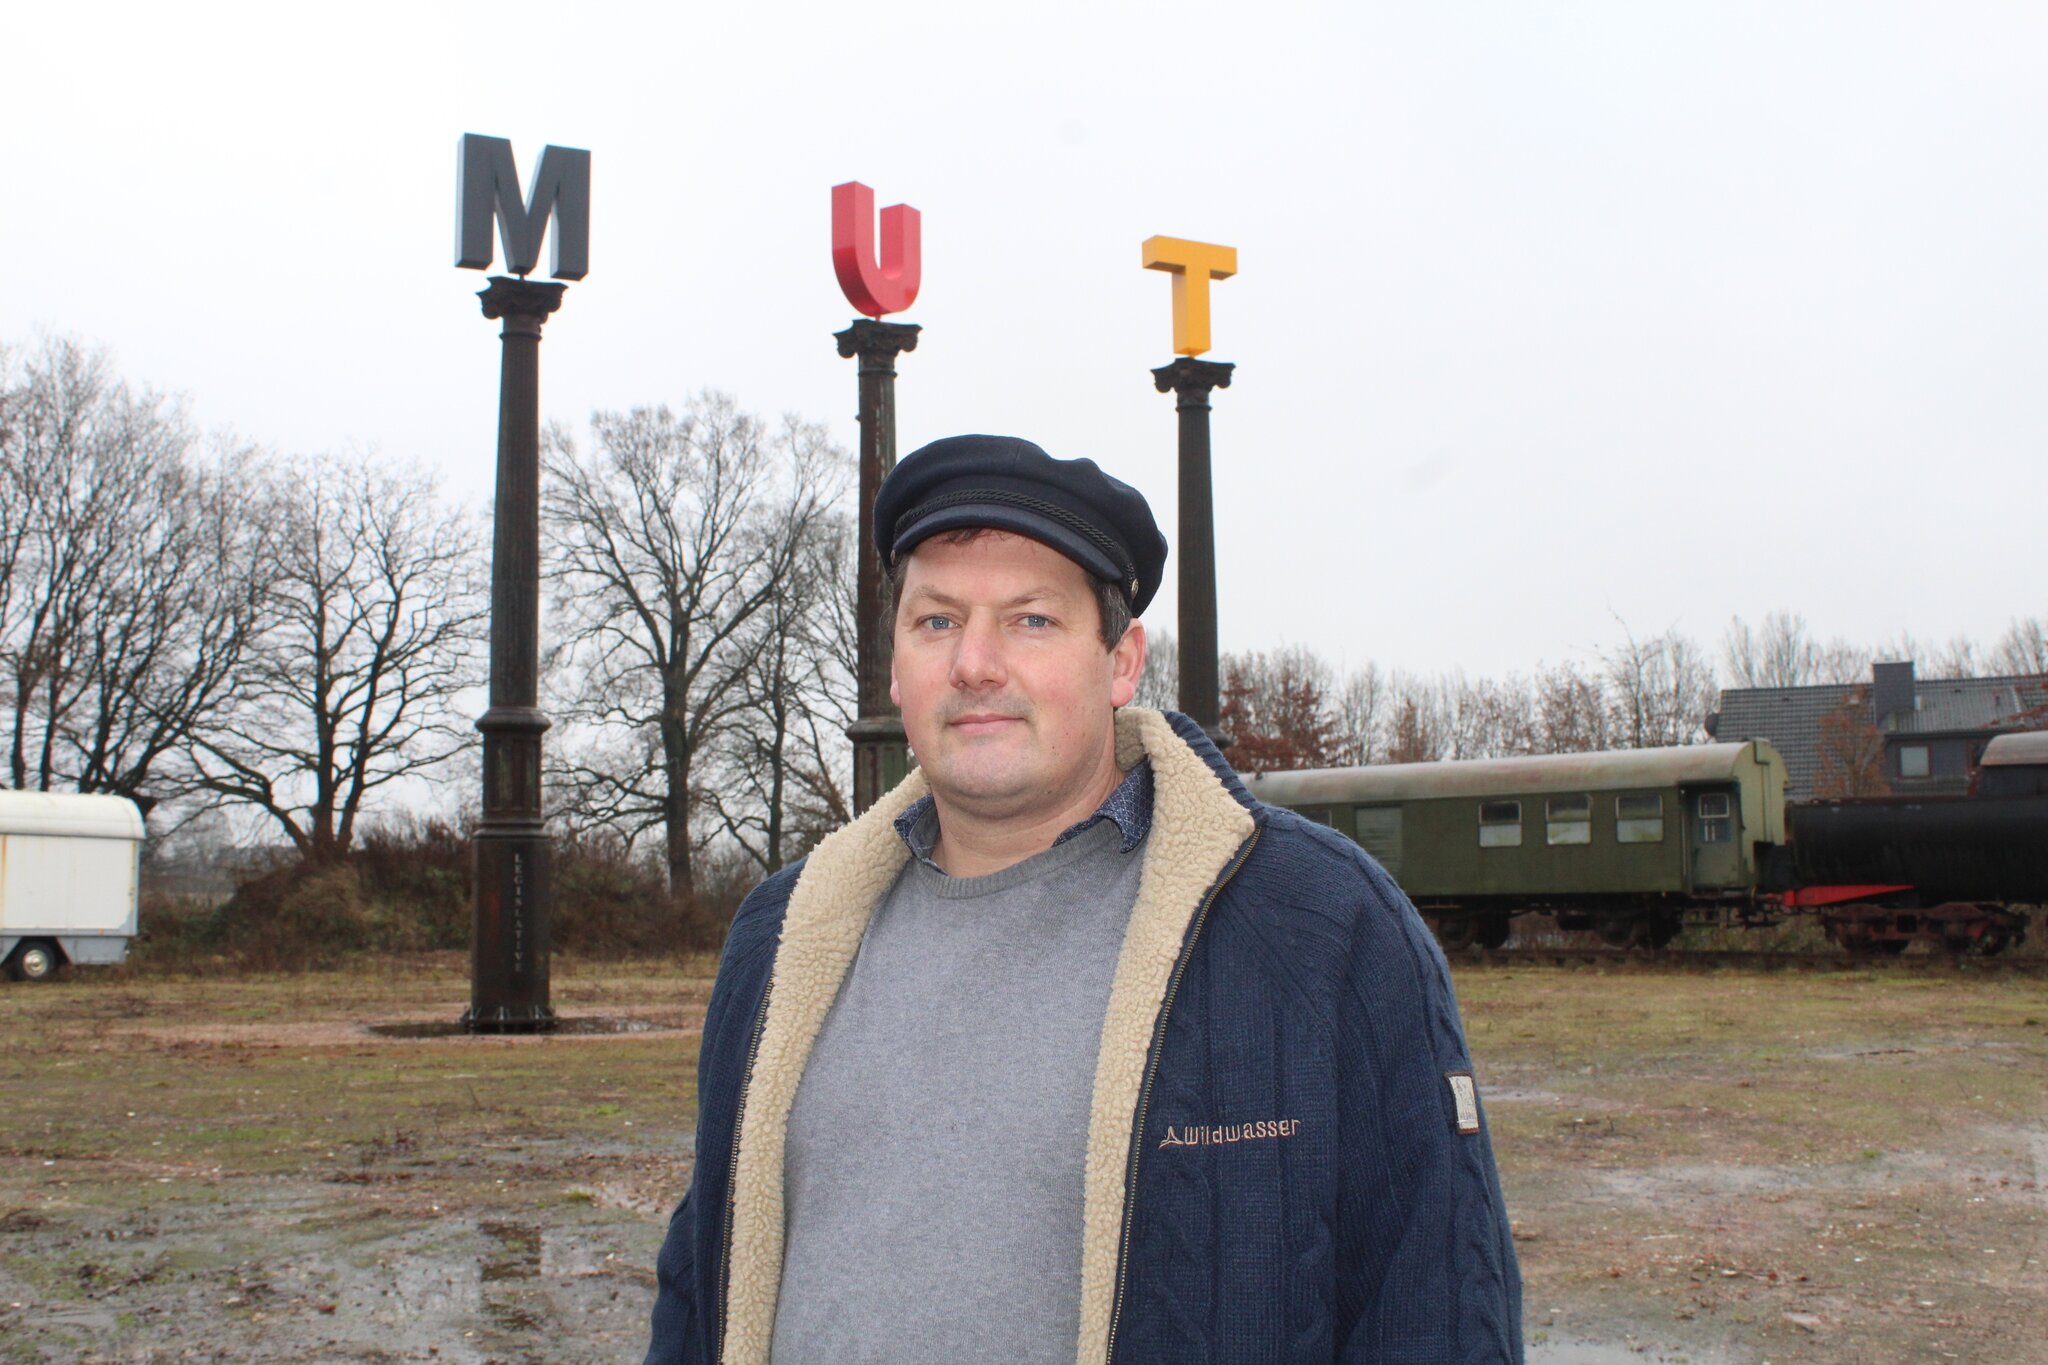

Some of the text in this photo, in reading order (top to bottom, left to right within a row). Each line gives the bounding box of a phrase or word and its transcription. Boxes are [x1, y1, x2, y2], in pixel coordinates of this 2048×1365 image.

[455, 132, 591, 281] M
[832, 180, 921, 318] U
[1142, 234, 1237, 358] T
[513, 852, 524, 973] LEGISLATIVE
